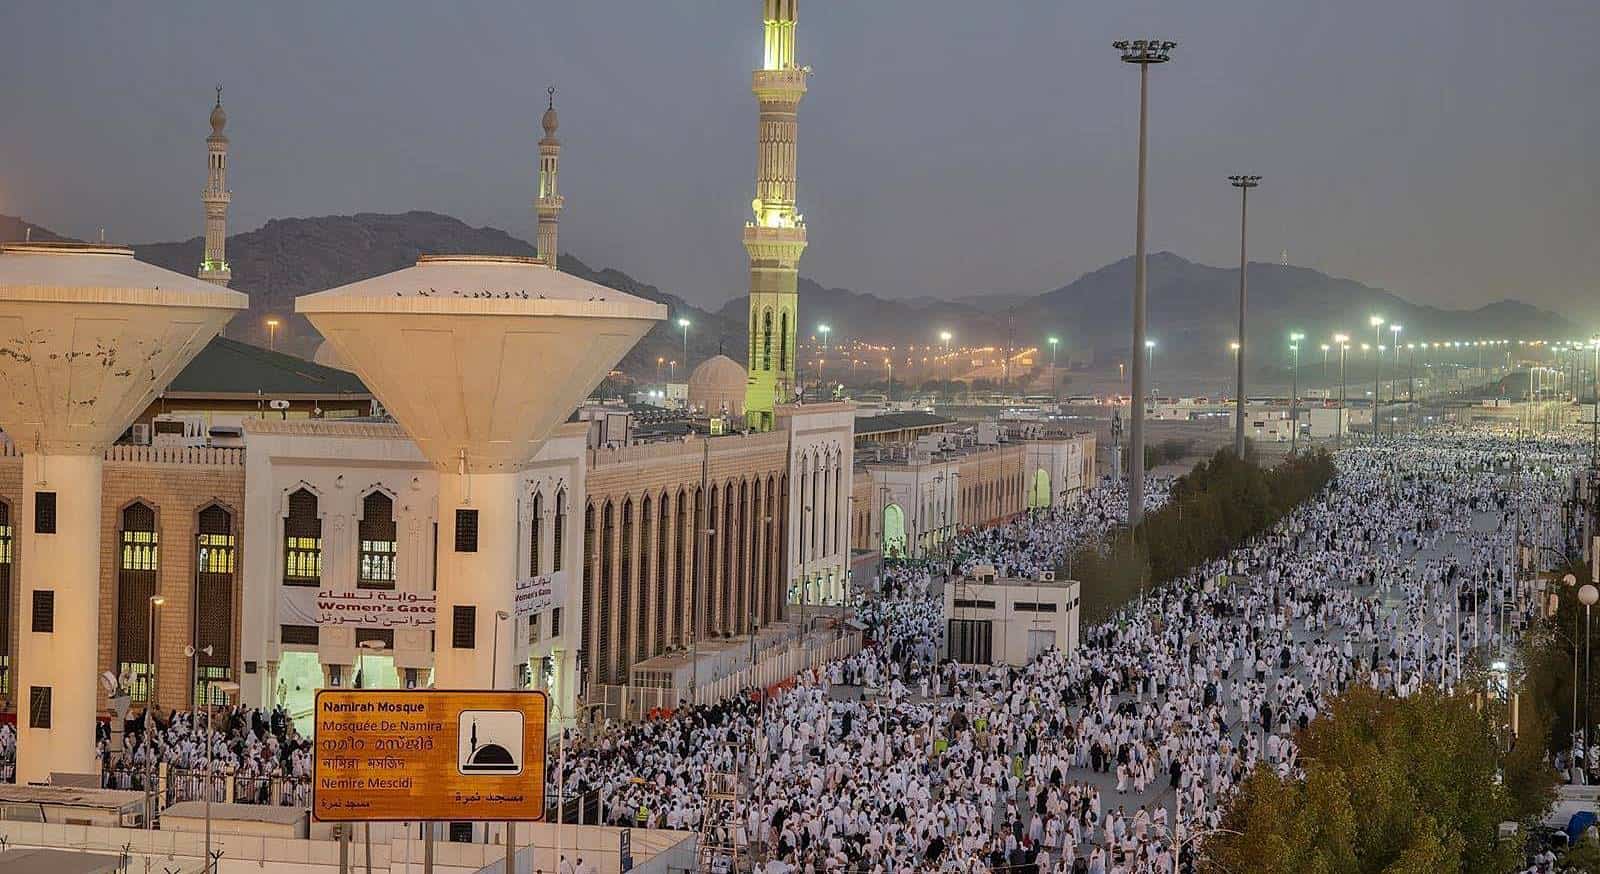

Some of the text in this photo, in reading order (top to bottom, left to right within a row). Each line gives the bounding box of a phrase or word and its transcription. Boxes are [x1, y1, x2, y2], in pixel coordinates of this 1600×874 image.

[317, 602, 437, 613] Women's Gate
[322, 701, 425, 715] Namirah Mosque
[321, 719, 442, 733] Mosquée De Namira
[321, 777, 413, 789] Nemire Mescidi
[455, 791, 524, 804] مسجد نمرة
